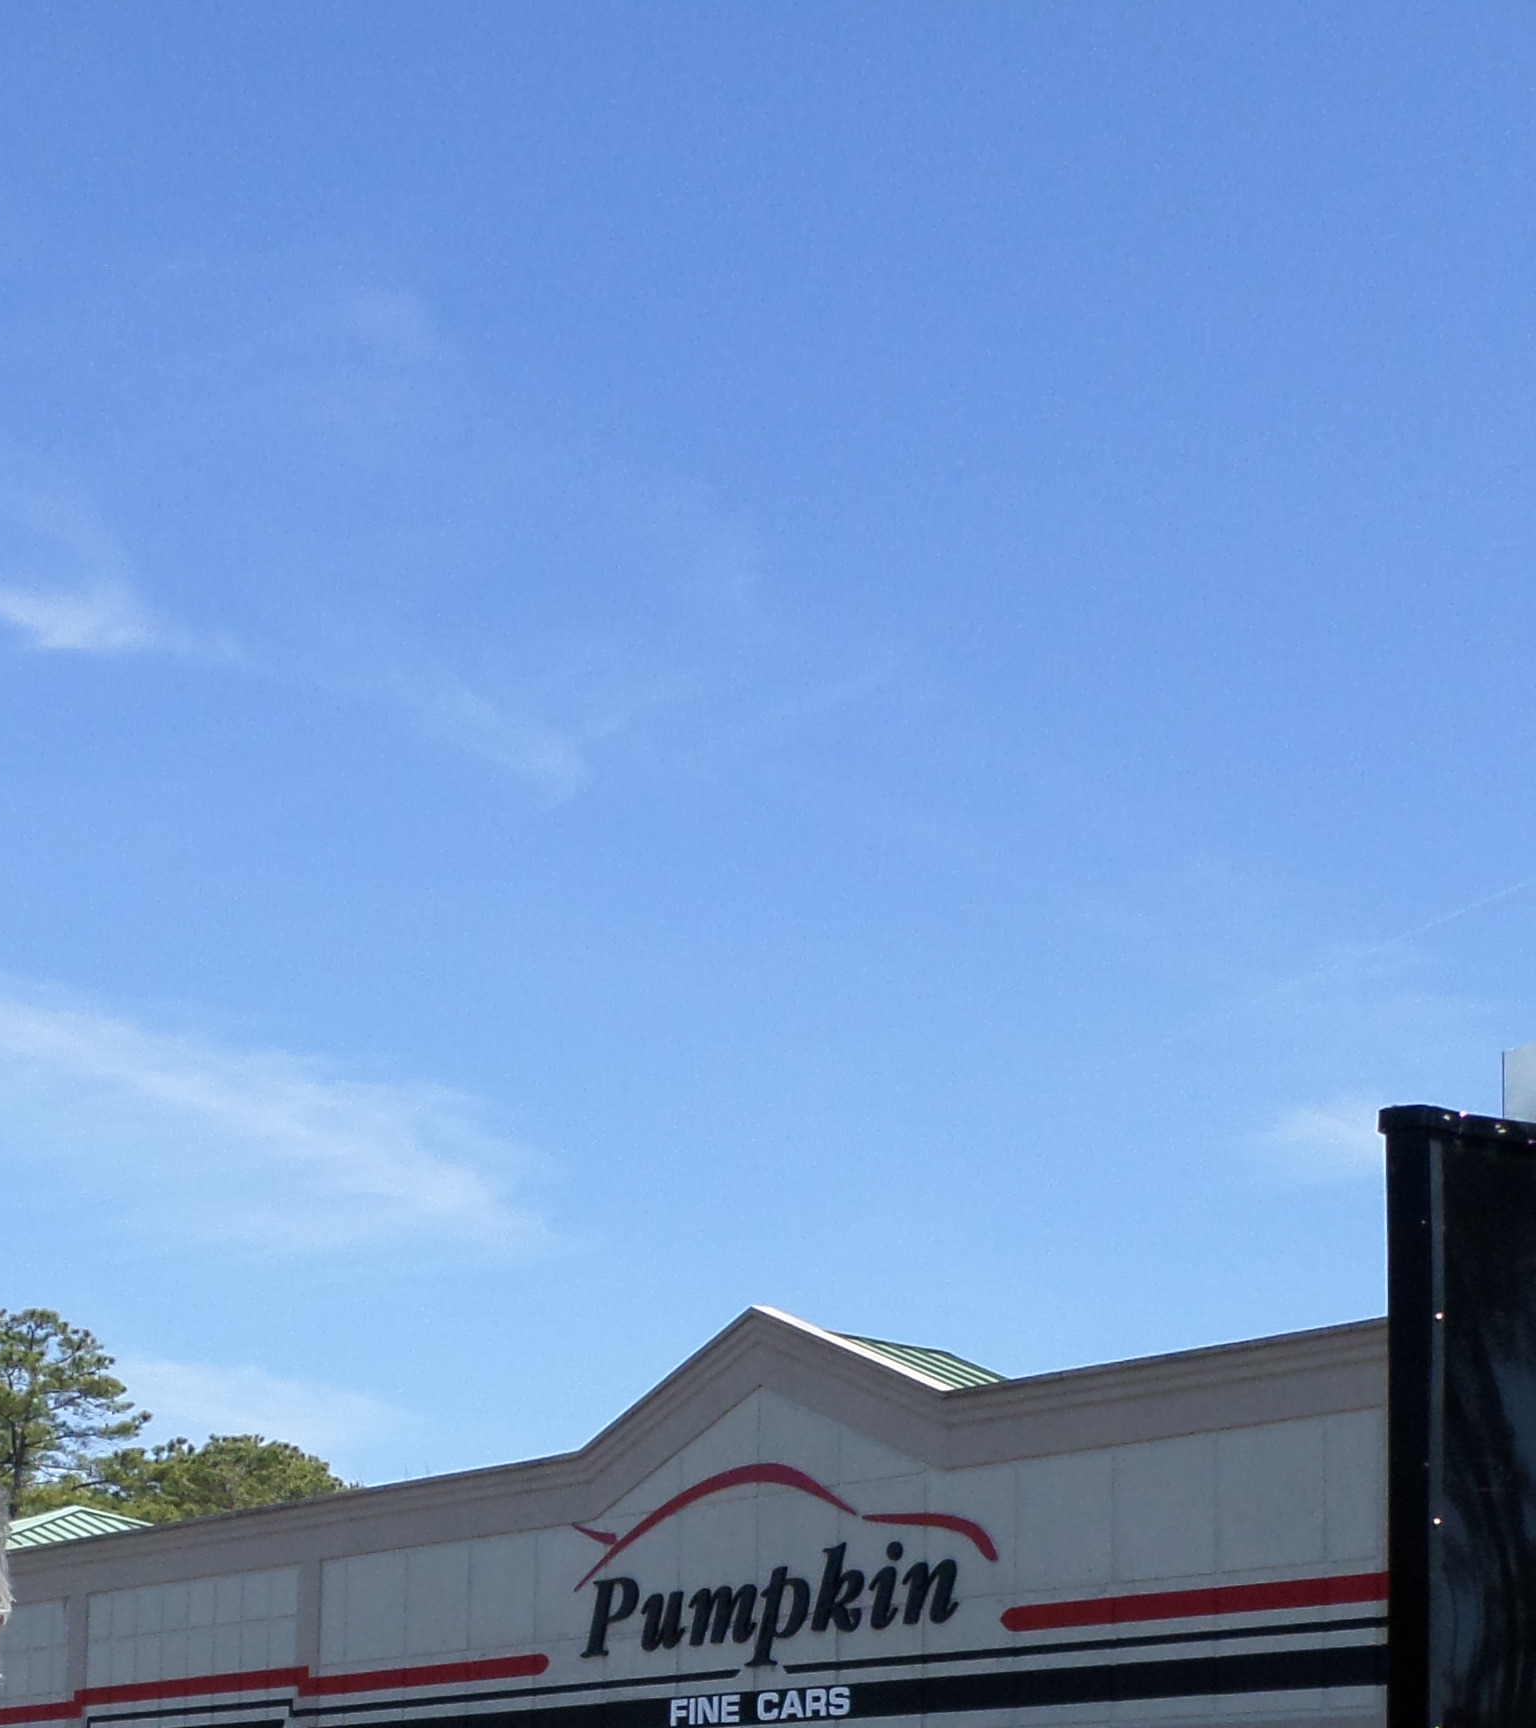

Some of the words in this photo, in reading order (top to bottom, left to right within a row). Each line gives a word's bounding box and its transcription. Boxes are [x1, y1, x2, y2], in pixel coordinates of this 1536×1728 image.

[579, 1540, 960, 1669] Pumpkin
[669, 1693, 741, 1727] FINE
[756, 1686, 851, 1722] CARS
